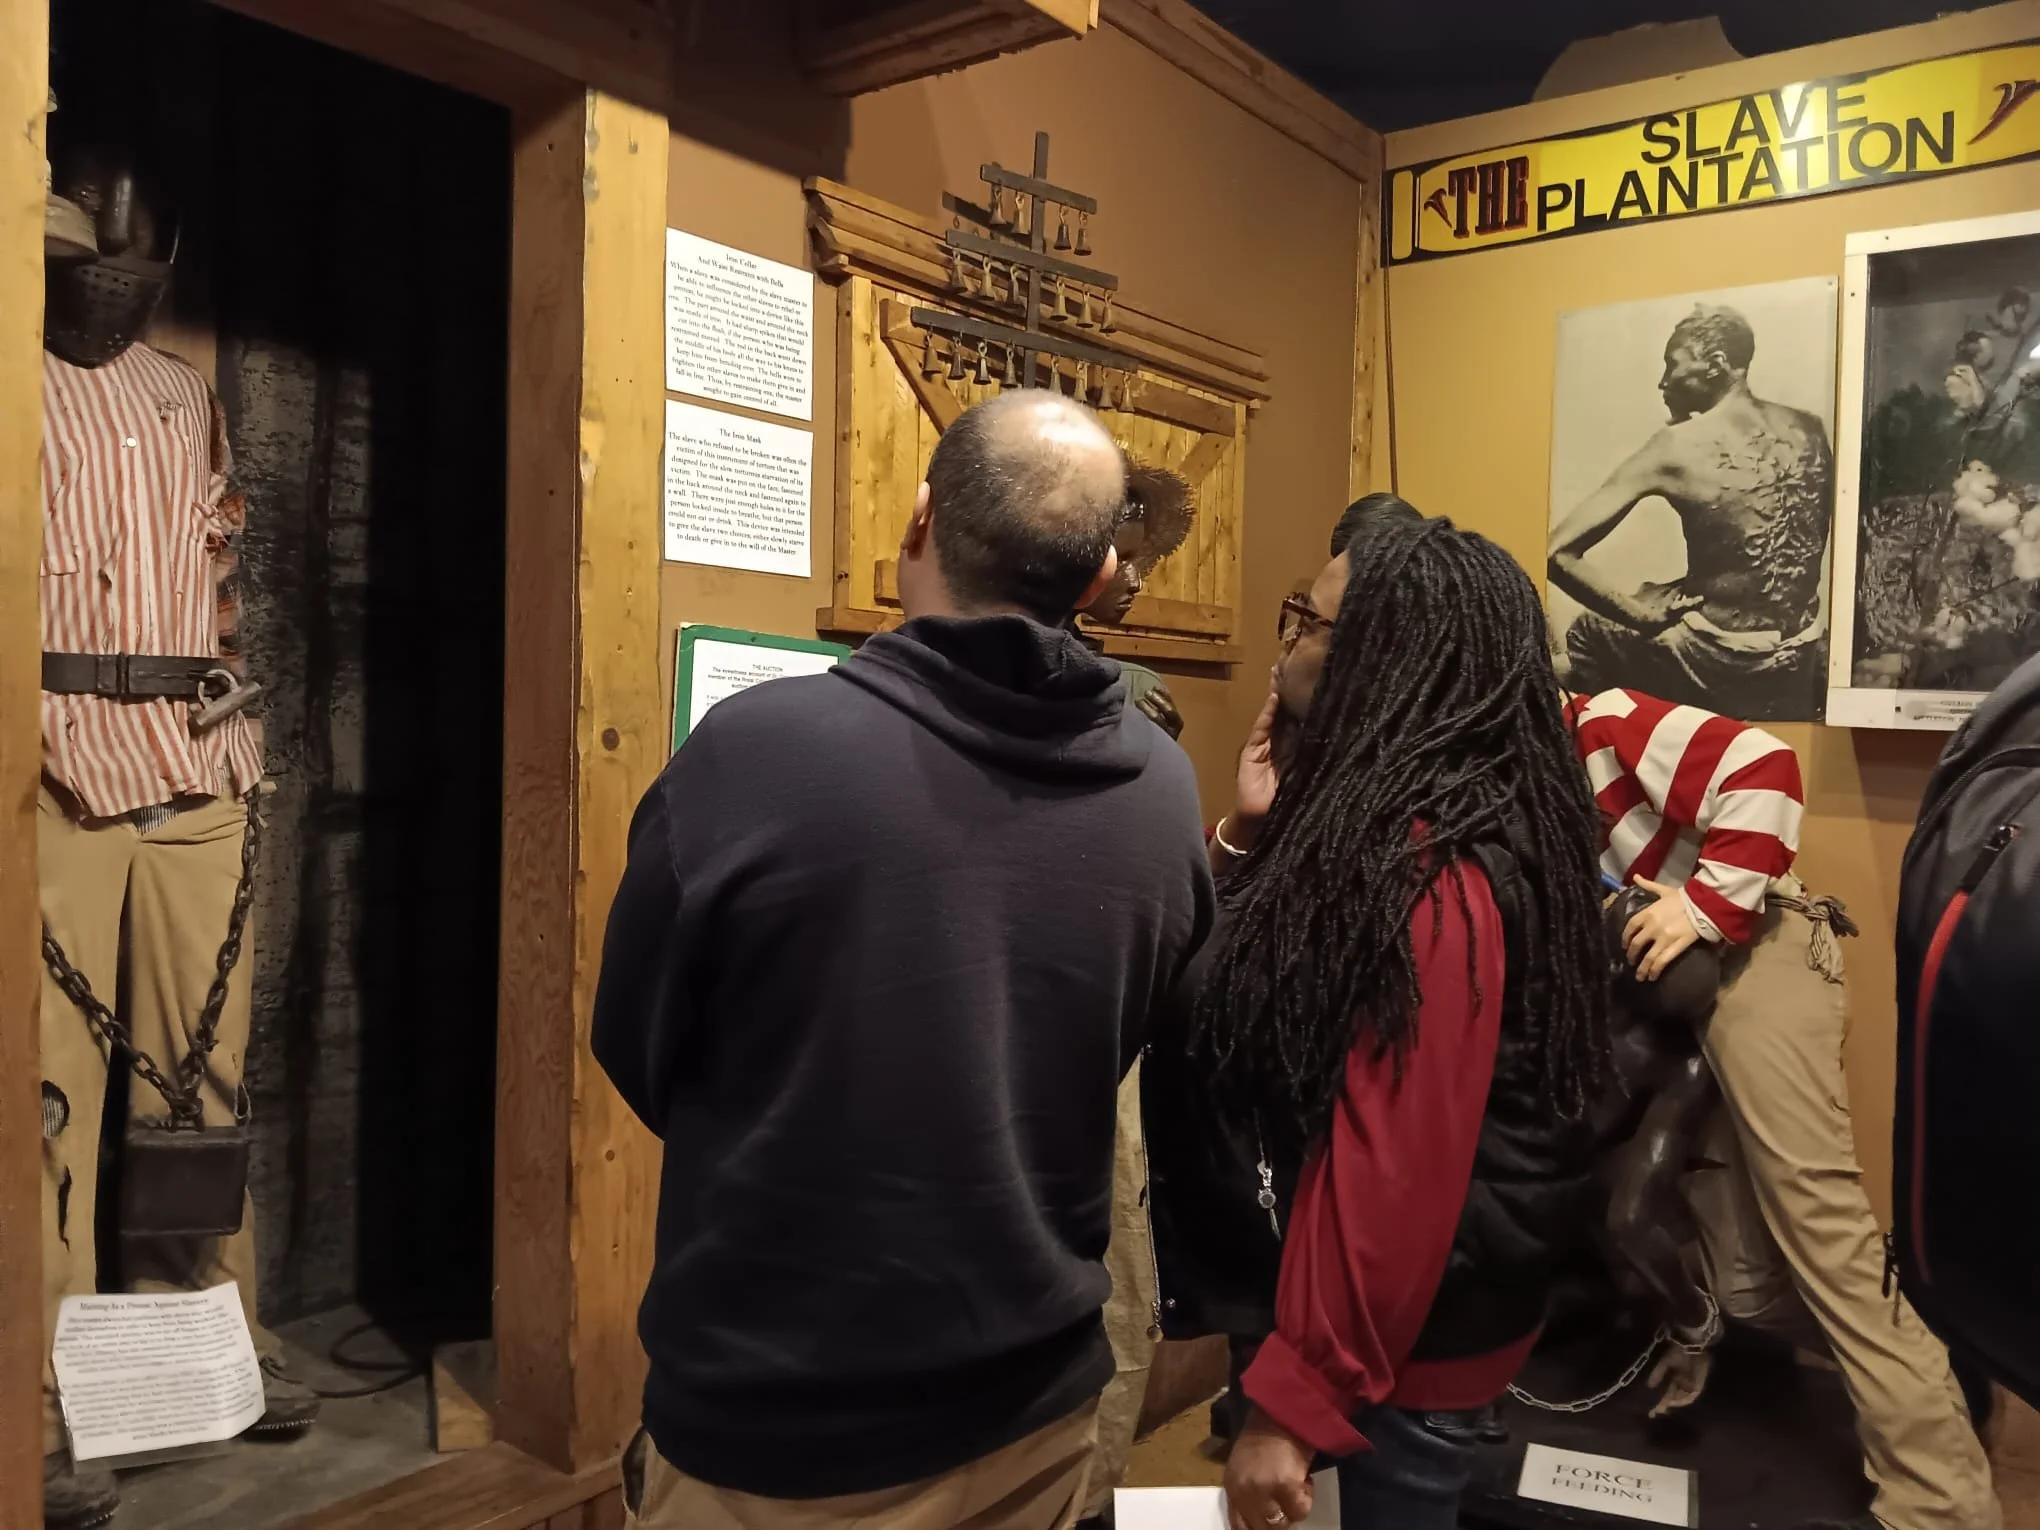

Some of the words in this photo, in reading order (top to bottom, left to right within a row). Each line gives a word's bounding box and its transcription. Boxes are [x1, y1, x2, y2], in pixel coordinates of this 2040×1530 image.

[1640, 76, 1869, 166] SLAVE
[1448, 155, 1530, 240] THE
[1536, 110, 1955, 233] PLANTATION
[1552, 1477, 1652, 1503] FEEDING
[1556, 1464, 1653, 1490] FORCE
